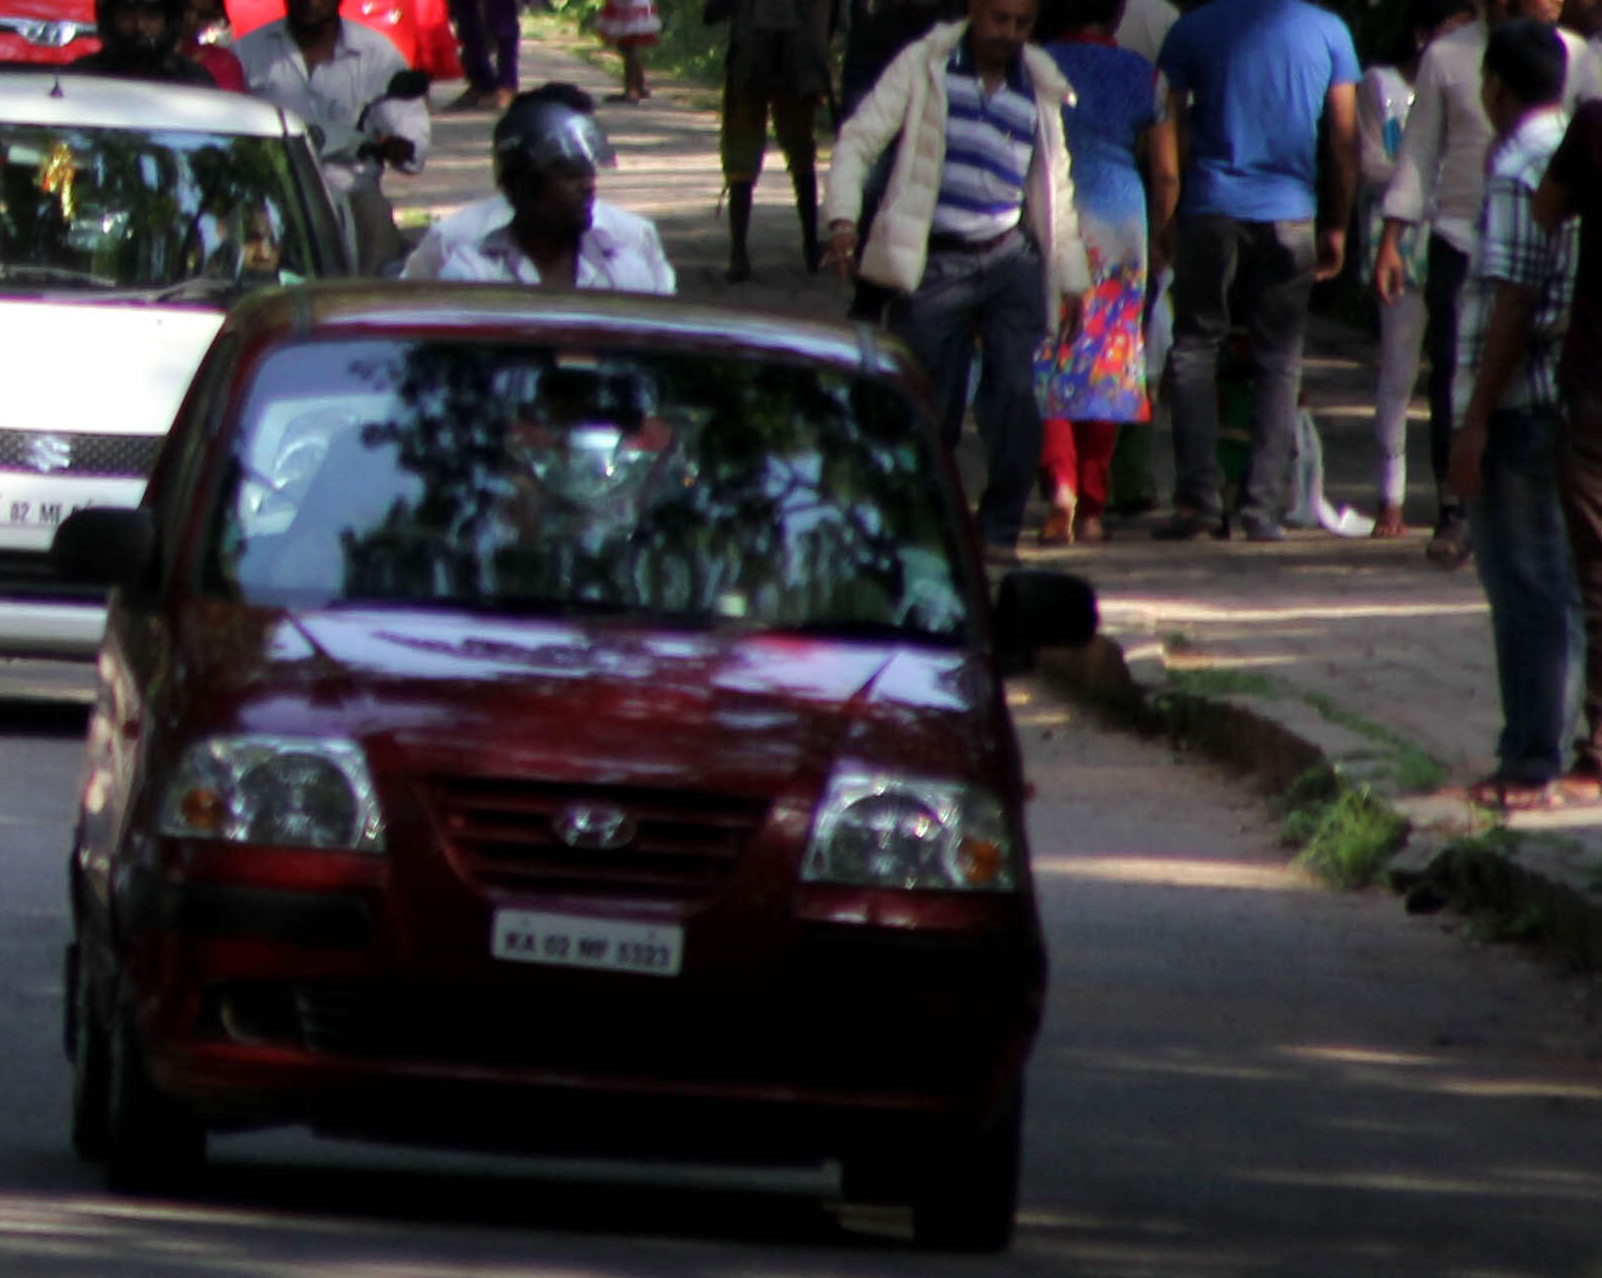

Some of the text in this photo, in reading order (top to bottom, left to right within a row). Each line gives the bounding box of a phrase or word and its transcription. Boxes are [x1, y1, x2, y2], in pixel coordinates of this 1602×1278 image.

[10, 501, 30, 522] 02
[504, 931, 535, 952] KA
[544, 934, 570, 956] 02
